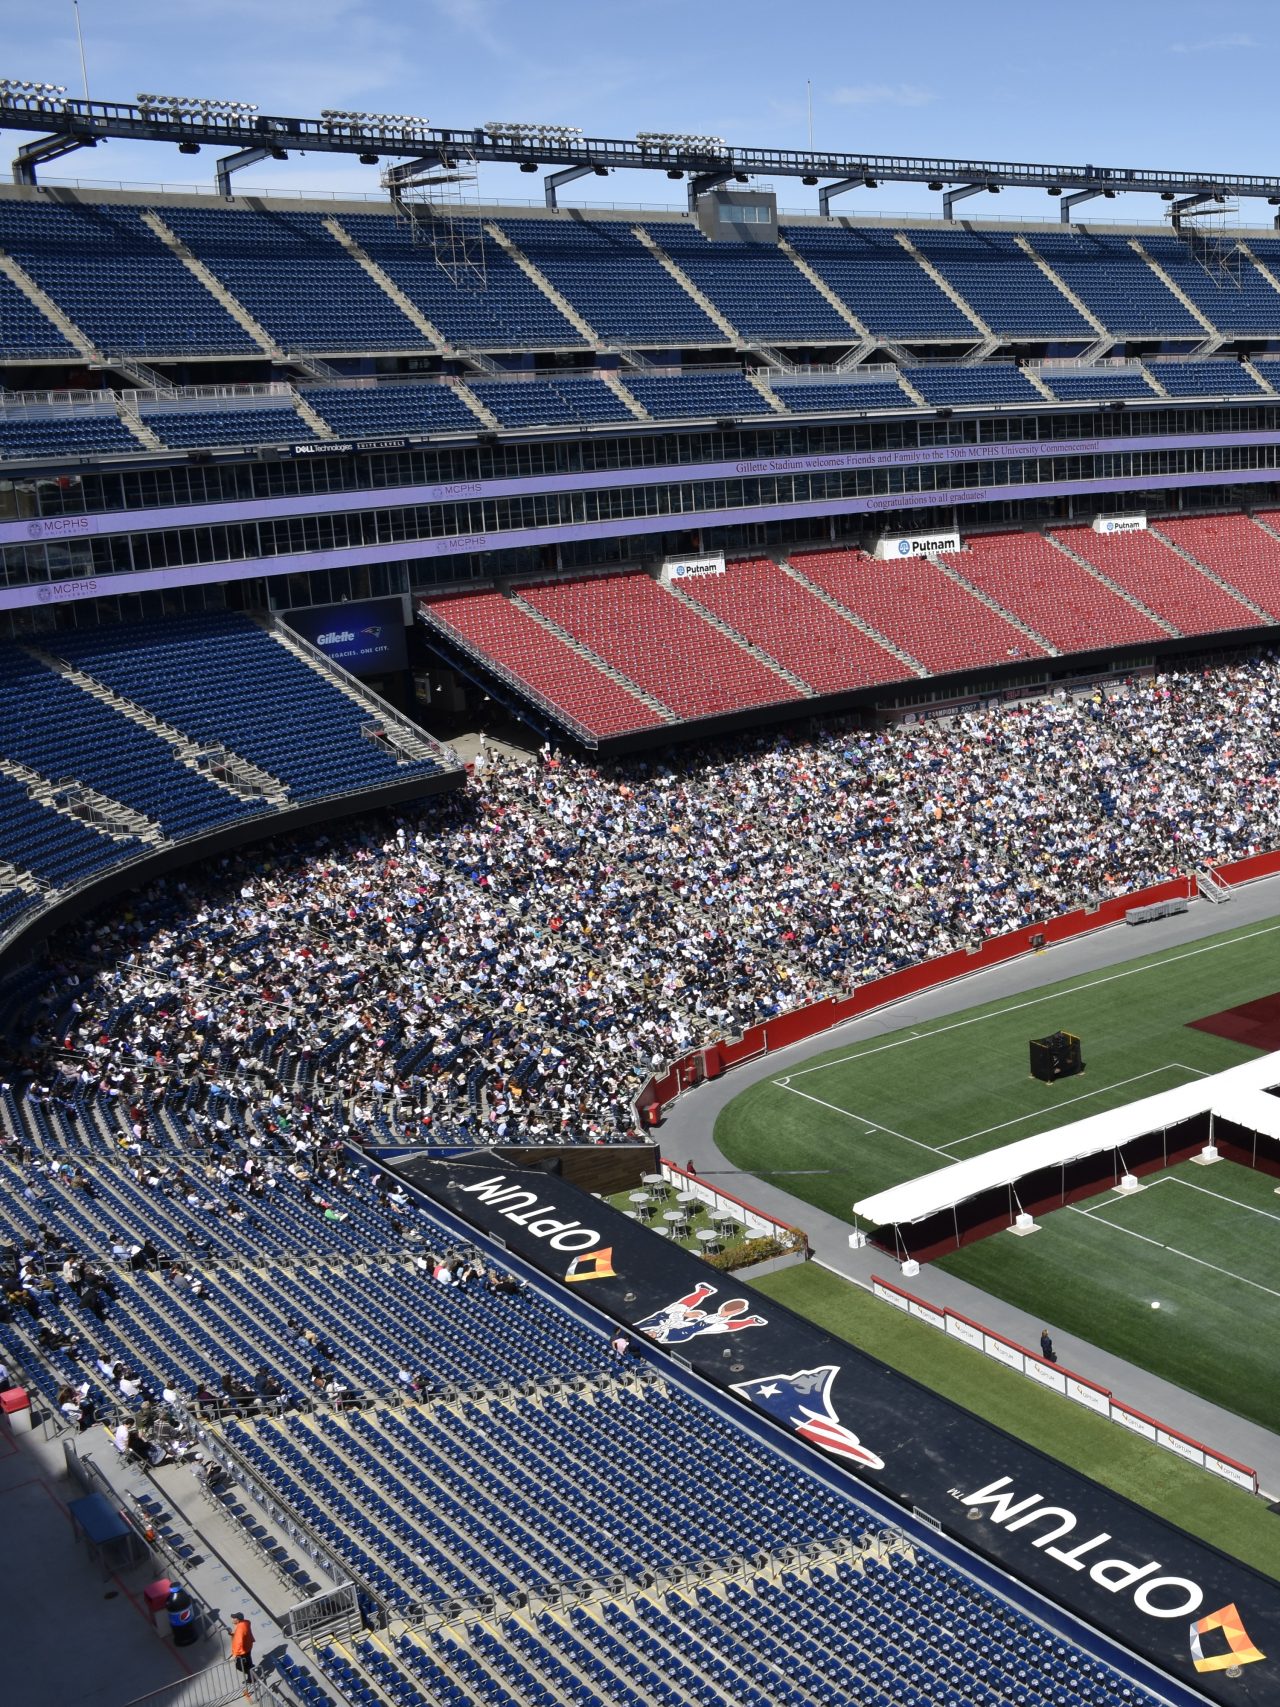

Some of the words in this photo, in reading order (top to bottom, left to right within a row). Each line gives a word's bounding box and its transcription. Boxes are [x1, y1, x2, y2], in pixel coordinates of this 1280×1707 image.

[295, 444, 315, 454] DELL
[314, 443, 353, 453] Technologies
[736, 463, 768, 473] Gillette
[769, 460, 803, 471] Stadium
[805, 457, 845, 468] welcomes
[846, 454, 876, 465] Friends
[877, 452, 892, 463] and
[894, 451, 921, 464] Family
[932, 451, 944, 459] the
[946, 449, 966, 459] 150th
[968, 446, 999, 457] MCPHS
[1001, 444, 1039, 456] University
[1041, 441, 1100, 452] Commencement!
[445, 483, 482, 494] MCPHS
[867, 495, 927, 509] Congratulations
[928, 495, 937, 503] to
[938, 493, 948, 502] all
[949, 490, 987, 503] graduates!
[44, 518, 89, 530] MCPHS
[449, 537, 486, 547] MCPHS
[912, 540, 955, 552] Putnam
[686, 564, 717, 573] Putnam
[53, 580, 97, 594] MCPHS
[317, 631, 355, 645] Gillette
[463, 1175, 601, 1251] OPTUM
[960, 1475, 1204, 1618] OPTUM
